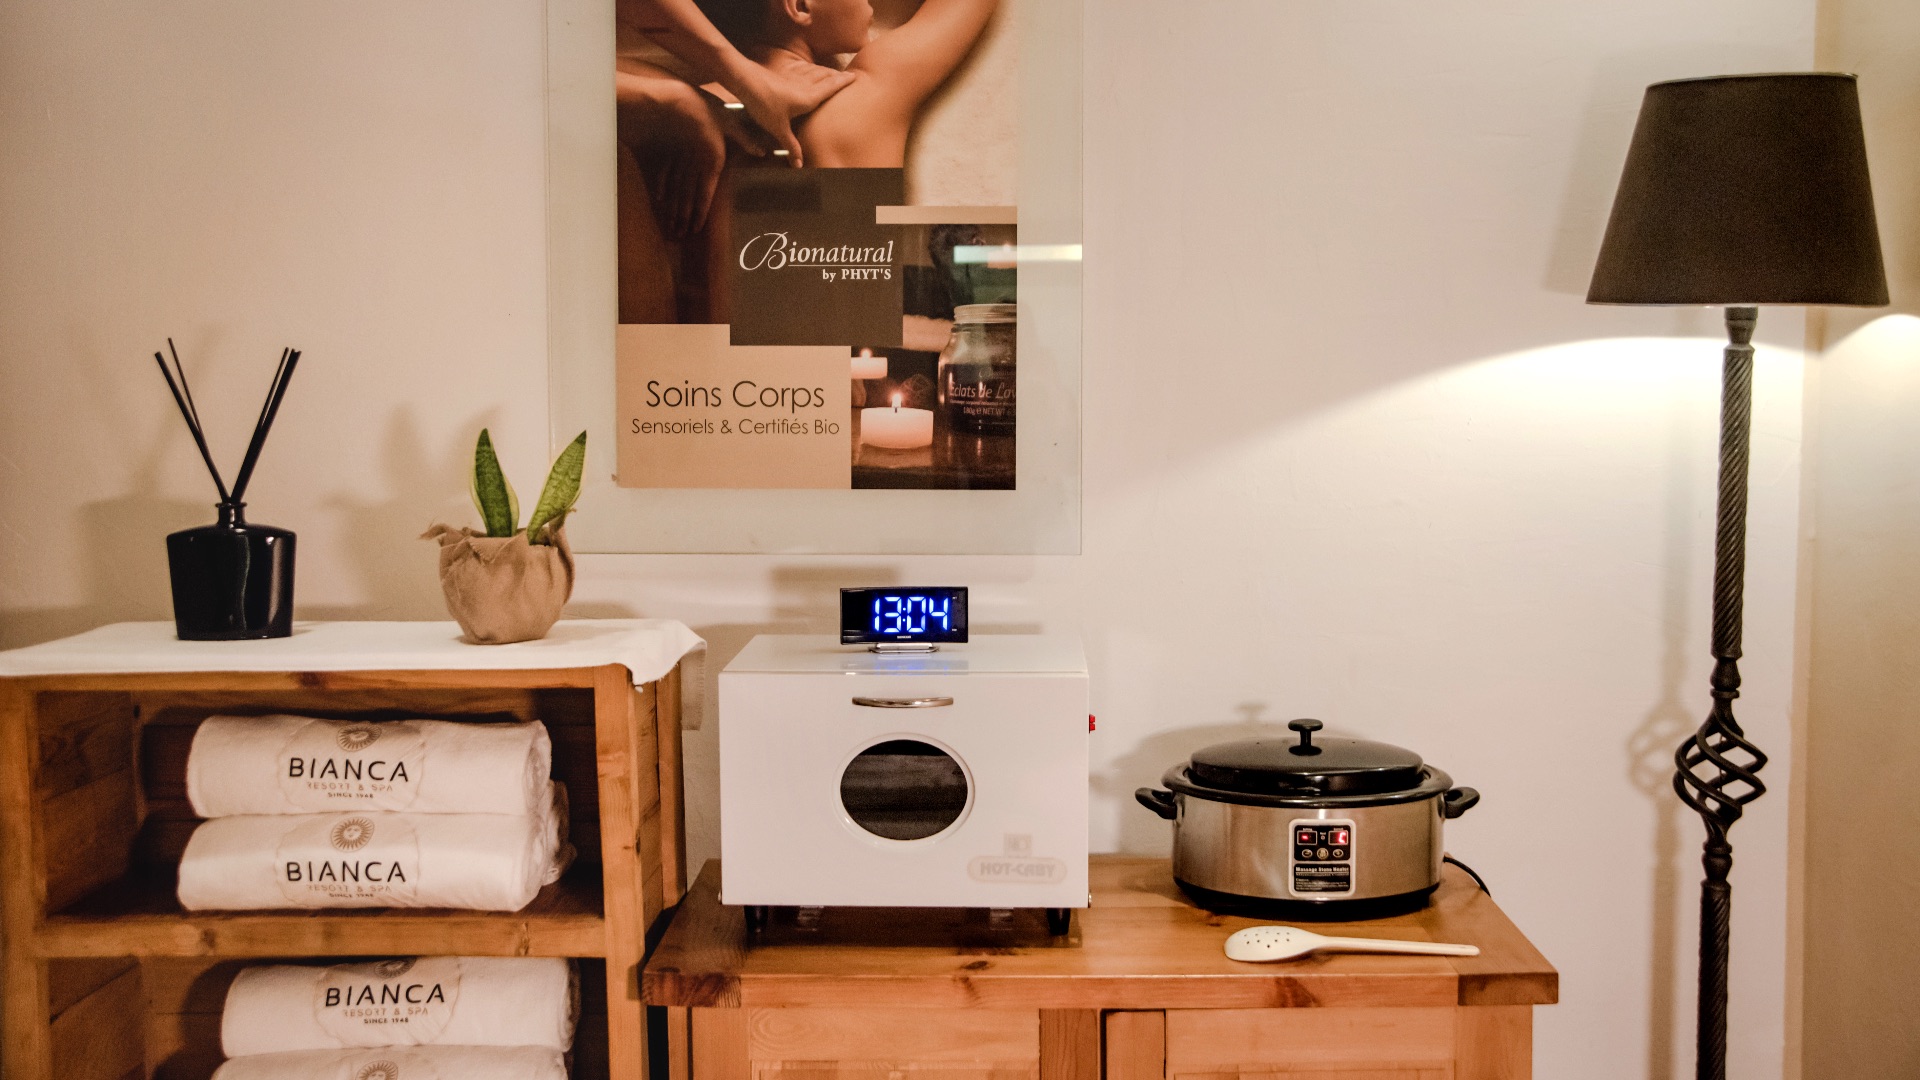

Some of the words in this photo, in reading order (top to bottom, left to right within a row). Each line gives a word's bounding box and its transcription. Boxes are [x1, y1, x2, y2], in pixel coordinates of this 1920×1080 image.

[739, 231, 894, 271] Bionatural
[822, 268, 837, 283] by
[841, 268, 892, 280] PHYT'S
[646, 380, 722, 408] Soins
[732, 380, 825, 414] Corps
[978, 384, 993, 399] de
[631, 418, 714, 434] Sensoriels
[720, 419, 733, 434] &
[738, 418, 809, 435] Certifiés
[814, 419, 840, 435] Bio
[874, 596, 949, 633] 13:04
[289, 757, 409, 782] BIANCA
[306, 781, 351, 791] RESORT
[371, 783, 393, 792] SPA
[286, 860, 406, 883] BIANCA
[325, 983, 445, 1007] BIANCA
[343, 1007, 388, 1017] RESORT
[407, 1006, 429, 1015] SPA
